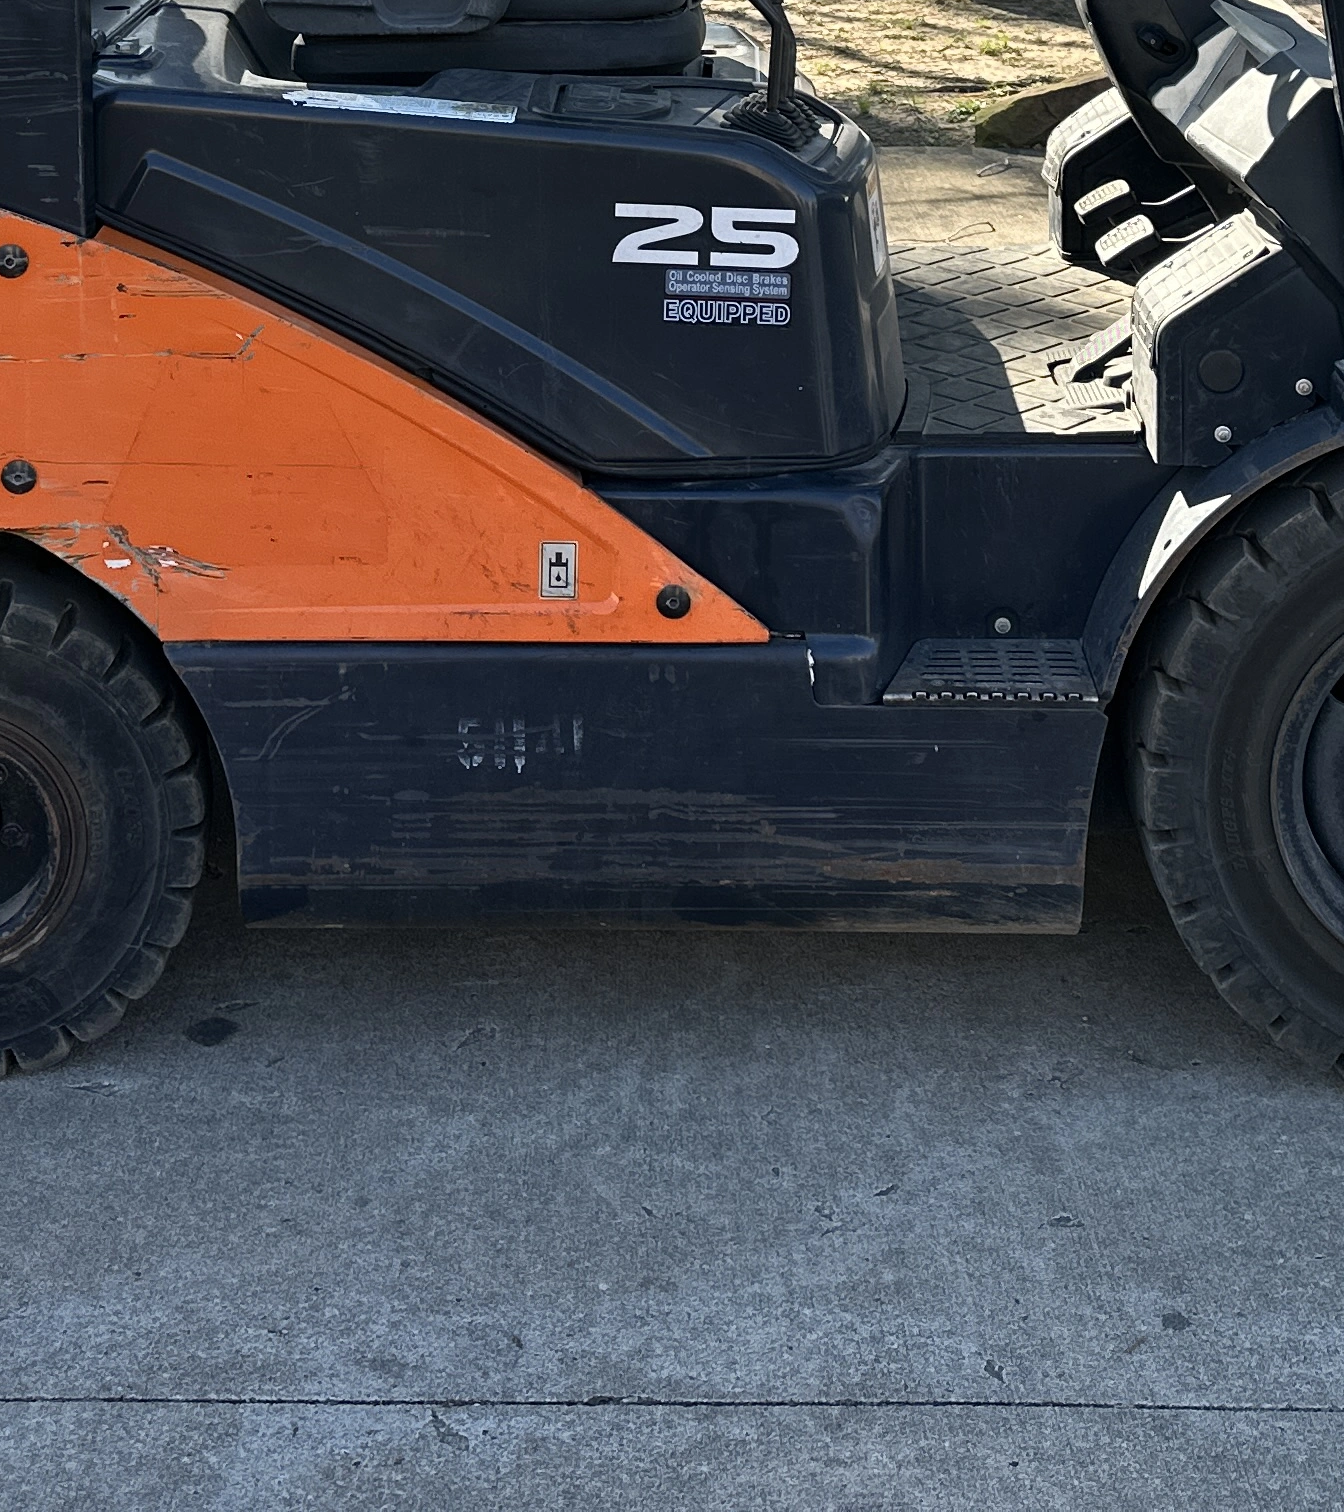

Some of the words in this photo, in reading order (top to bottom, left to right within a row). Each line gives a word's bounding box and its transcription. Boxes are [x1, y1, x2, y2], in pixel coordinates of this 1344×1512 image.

[612, 202, 800, 269] 25
[669, 270, 683, 282] Oil
[686, 271, 722, 283] Cooled
[726, 272, 749, 283] Disc
[752, 273, 788, 285] Brakes
[668, 281, 710, 293] Operator
[712, 282, 751, 296] Sensing
[752, 283, 788, 296] System
[663, 299, 791, 326] EQUIPPED
